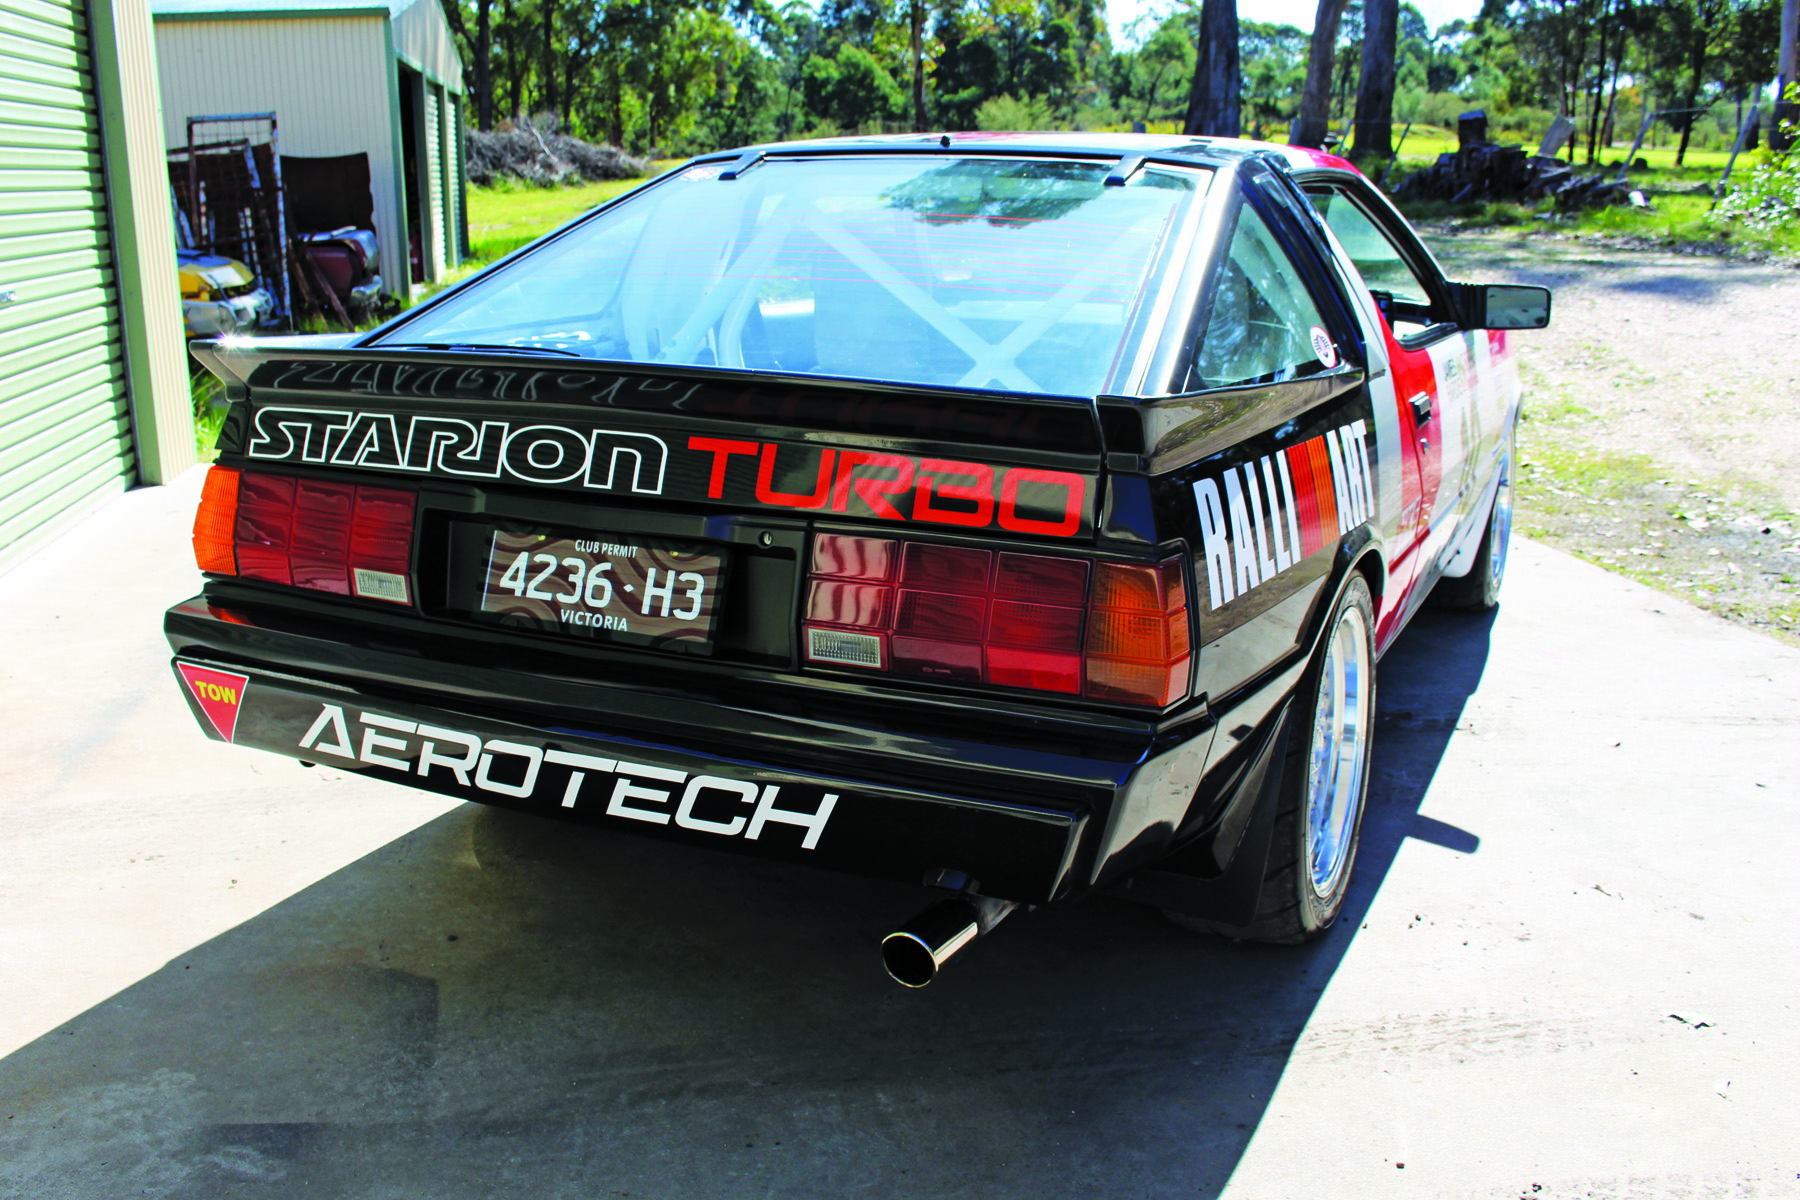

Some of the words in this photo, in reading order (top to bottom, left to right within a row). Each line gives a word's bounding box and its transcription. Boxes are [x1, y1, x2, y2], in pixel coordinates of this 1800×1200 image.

[249, 407, 668, 495] STARION
[687, 436, 1086, 538] TURBO
[575, 539, 599, 554] CLUB
[601, 543, 638, 558] PERMIT
[1192, 449, 1302, 611] RALLI
[1326, 418, 1375, 536] ART
[560, 609, 628, 632] VICTORIA
[195, 680, 237, 706] TOW
[298, 703, 840, 850] AEROTECH
